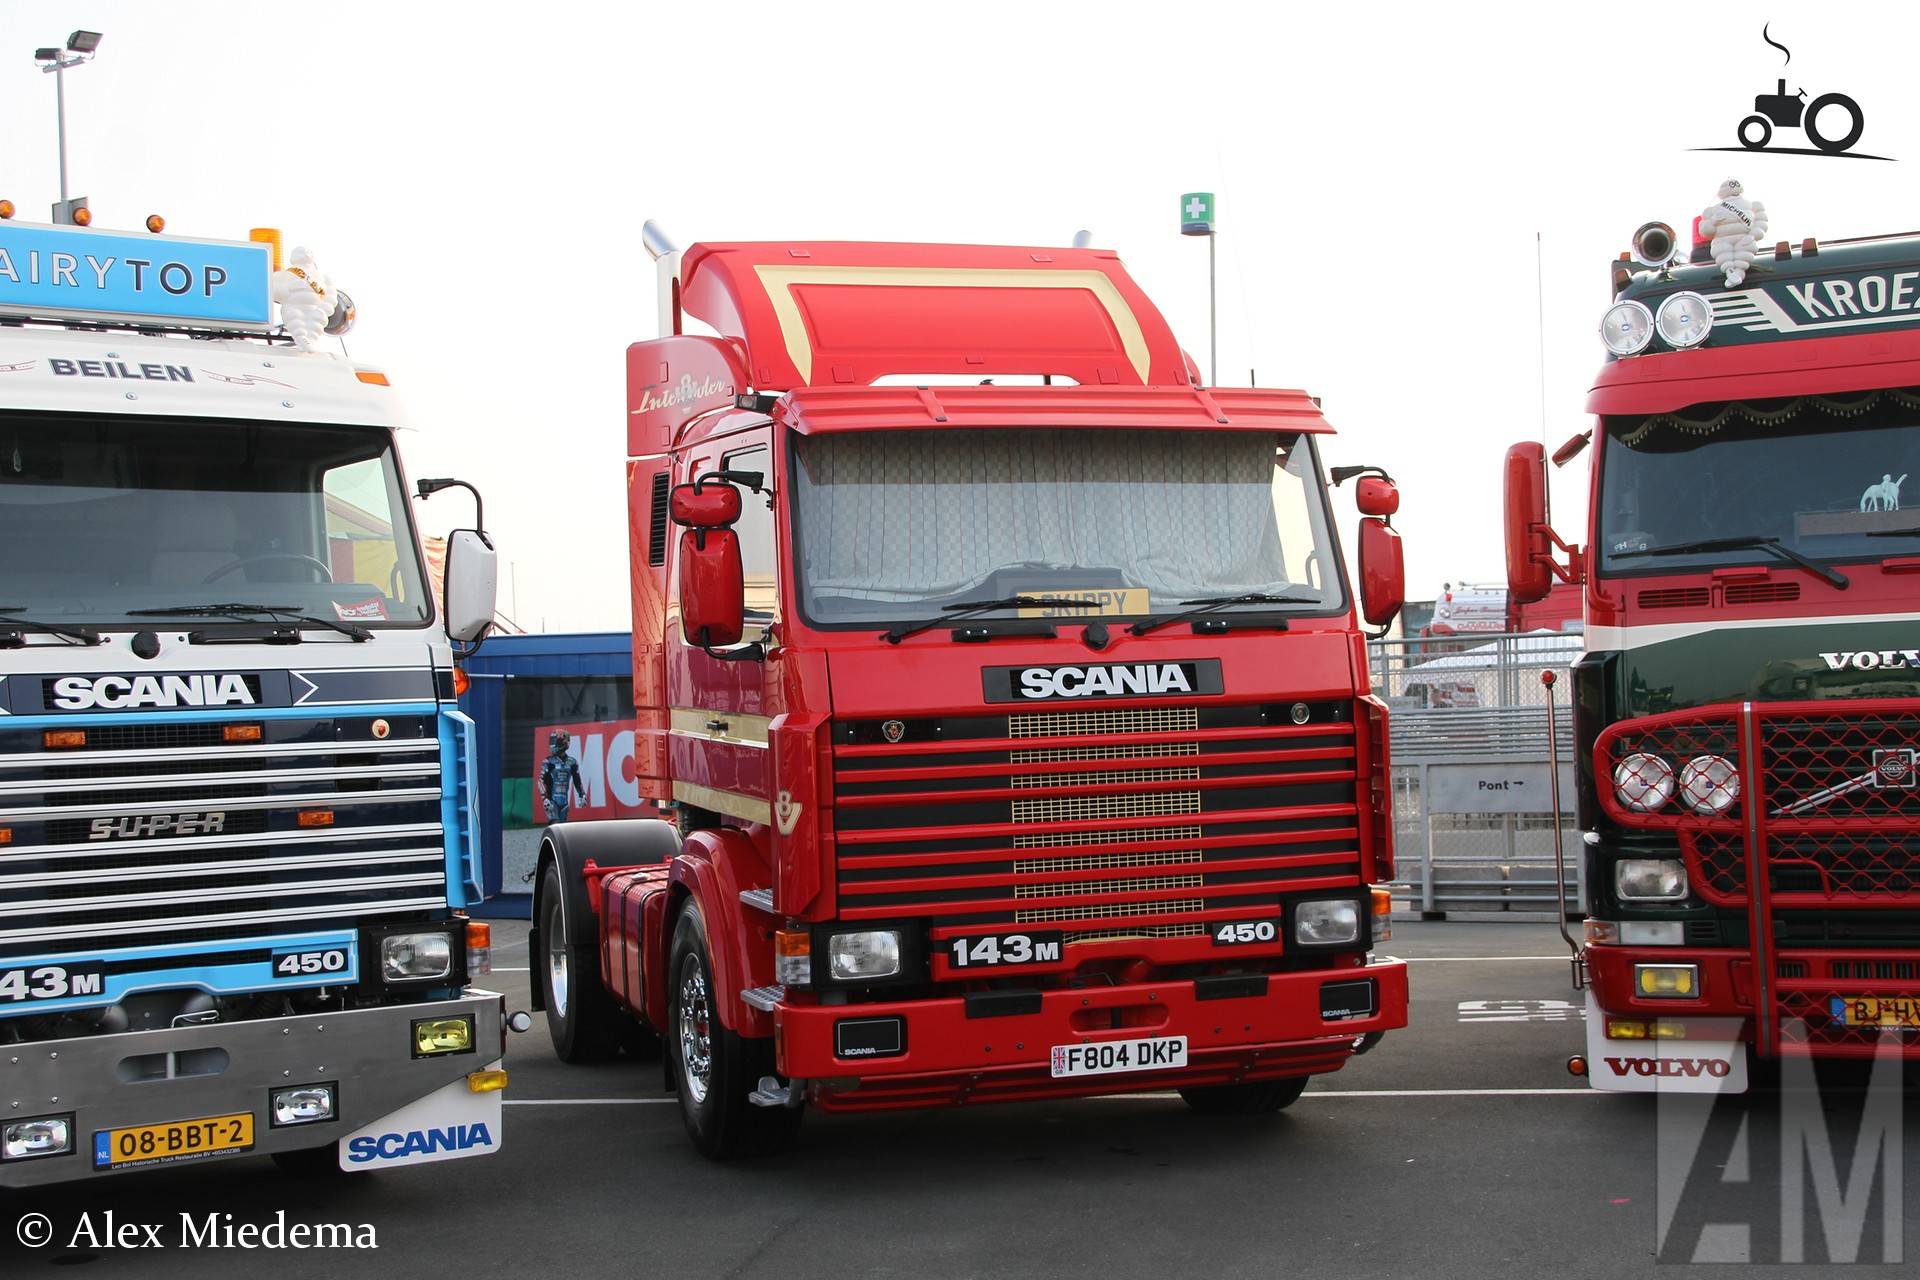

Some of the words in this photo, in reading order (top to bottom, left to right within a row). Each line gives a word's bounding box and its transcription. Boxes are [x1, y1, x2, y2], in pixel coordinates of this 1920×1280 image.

[1721, 201, 1752, 227] MICHELIN
[1785, 271, 1920, 319] KROE
[48, 357, 196, 383] BEILEN
[1040, 591, 1127, 618] SKIPPY
[53, 673, 256, 710] SCANIA
[1020, 663, 1192, 699] SCANIA
[1478, 780, 1509, 790] Pont
[88, 811, 227, 841] SUPER
[1216, 921, 1275, 943] 450
[277, 949, 346, 975] 450
[1322, 1009, 1351, 1017] SCANIA
[844, 1047, 877, 1056] SCANIA
[1068, 1044, 1130, 1071] F804
[1137, 1040, 1183, 1065] DKP
[1603, 1057, 1731, 1077] VOLVO
[119, 1119, 244, 1157] 08-BBT-2
[348, 1122, 494, 1163] SCANIA
[98, 1151, 109, 1159] NL
